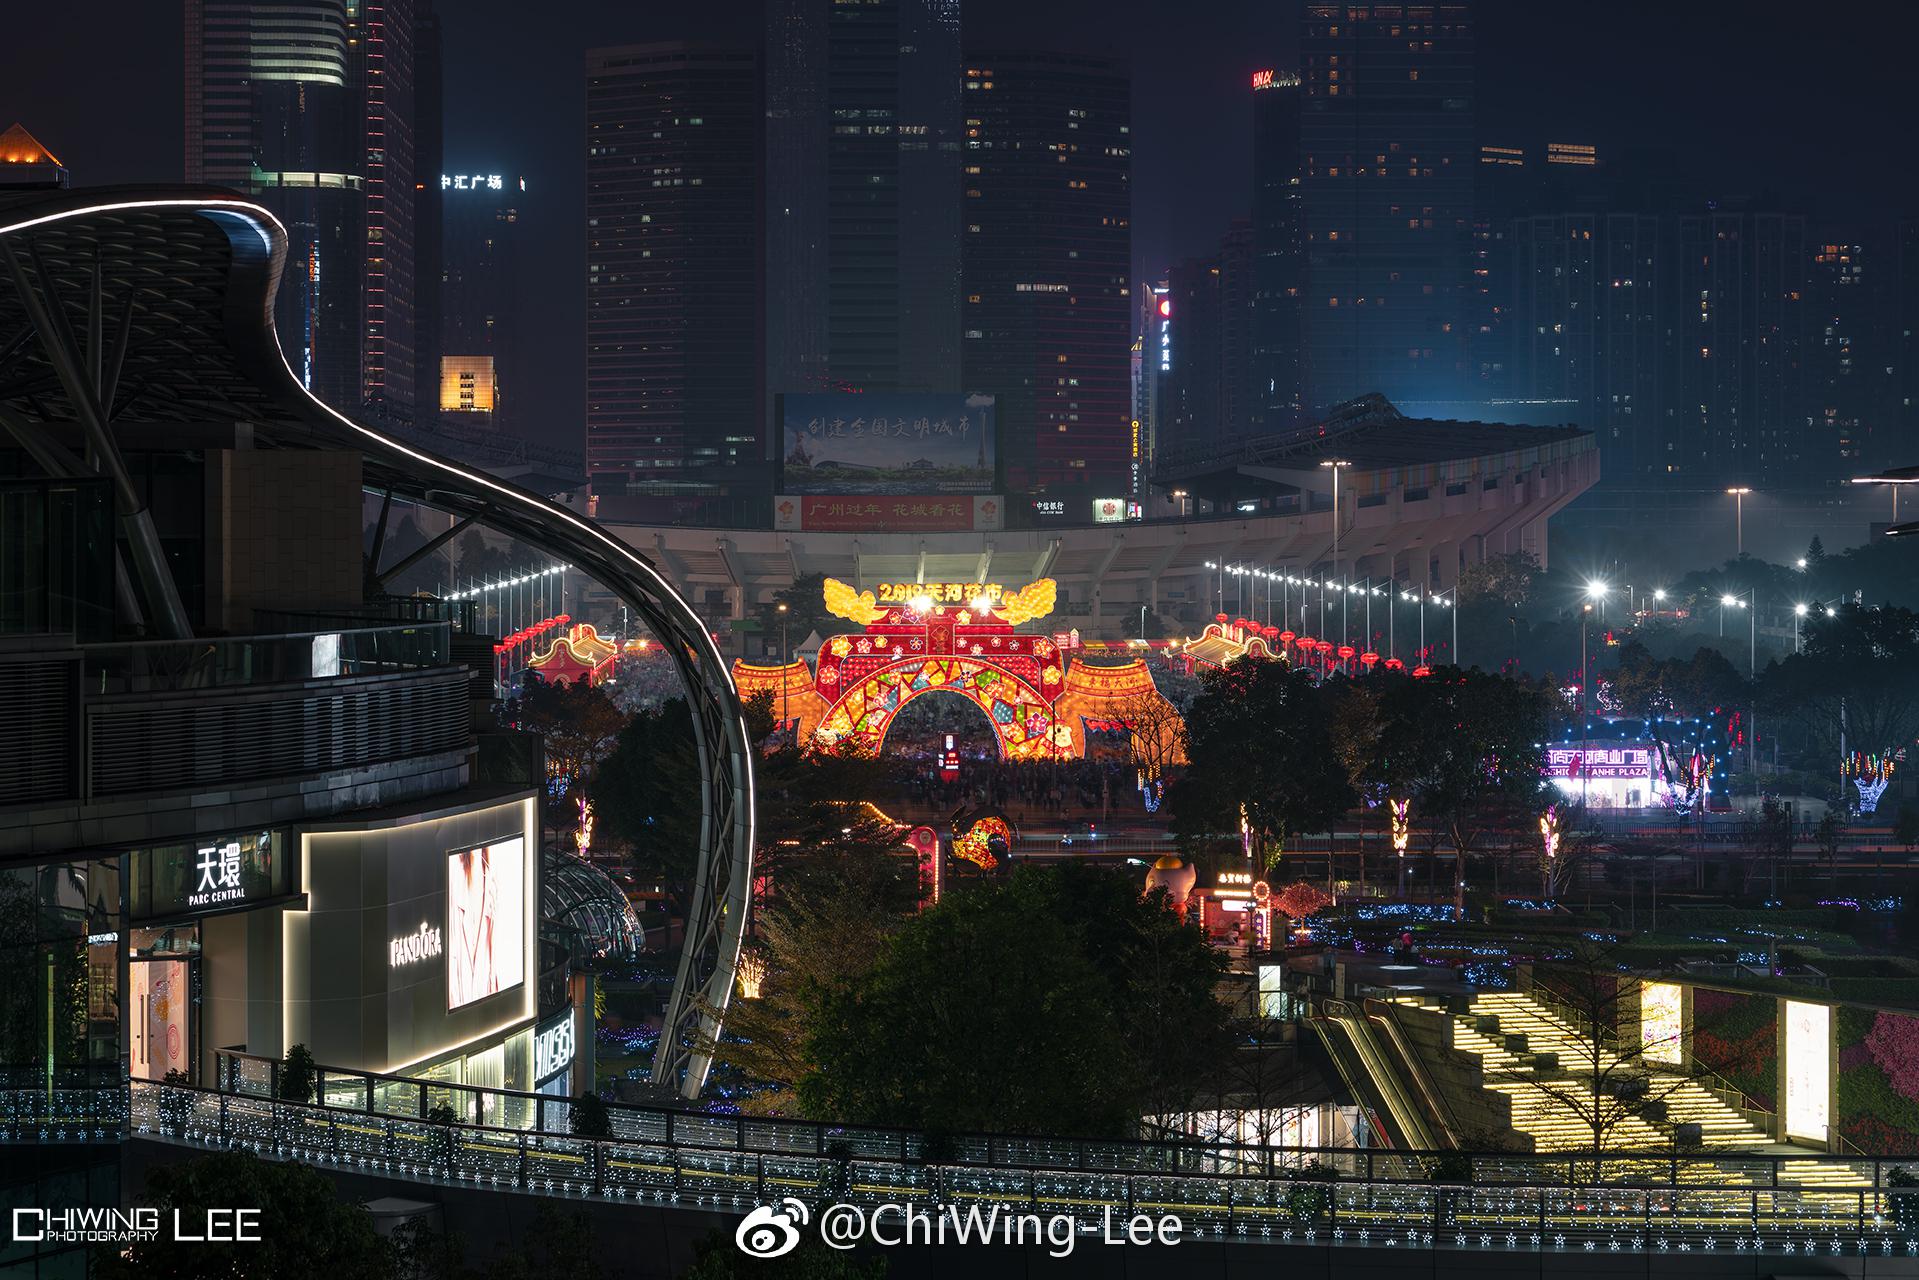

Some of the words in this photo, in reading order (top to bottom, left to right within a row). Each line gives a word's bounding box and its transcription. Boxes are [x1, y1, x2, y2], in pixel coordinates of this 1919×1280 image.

[441, 174, 503, 190] 中汇广场
[808, 416, 970, 440] 创建全国文明城市
[809, 503, 883, 517] 广州过年
[893, 503, 966, 517] 花城看花
[1618, 768, 1648, 776] PLAZA
[189, 893, 210, 906] PARC
[211, 888, 246, 903] CENTRAL
[390, 922, 442, 968] PANDORA
